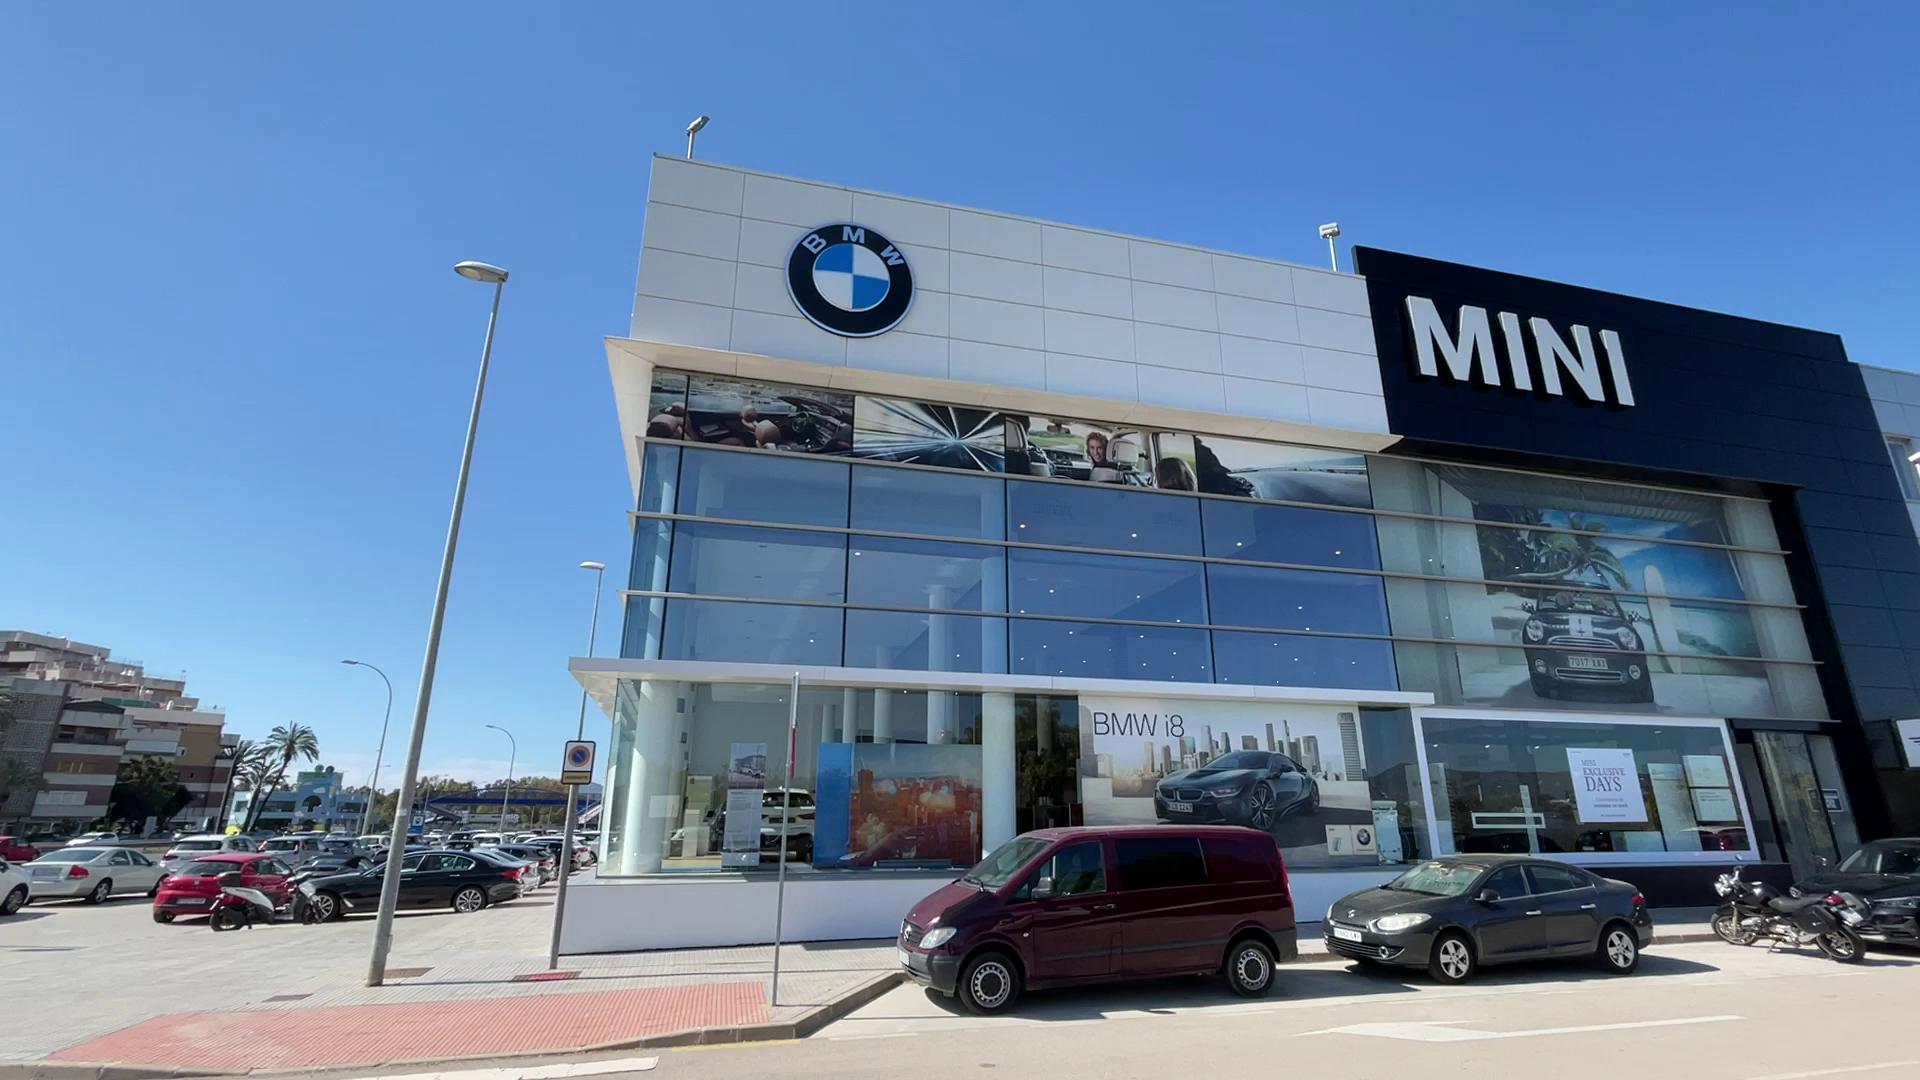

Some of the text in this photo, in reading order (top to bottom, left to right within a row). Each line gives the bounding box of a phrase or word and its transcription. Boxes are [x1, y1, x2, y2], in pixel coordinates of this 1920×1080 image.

[802, 226, 905, 267] BMW
[1405, 295, 1636, 407] MINI
[1093, 712, 1185, 738] BMW i8
[1583, 768, 1626, 776] EXCLUSIVE
[1585, 776, 1622, 792] DAYS
